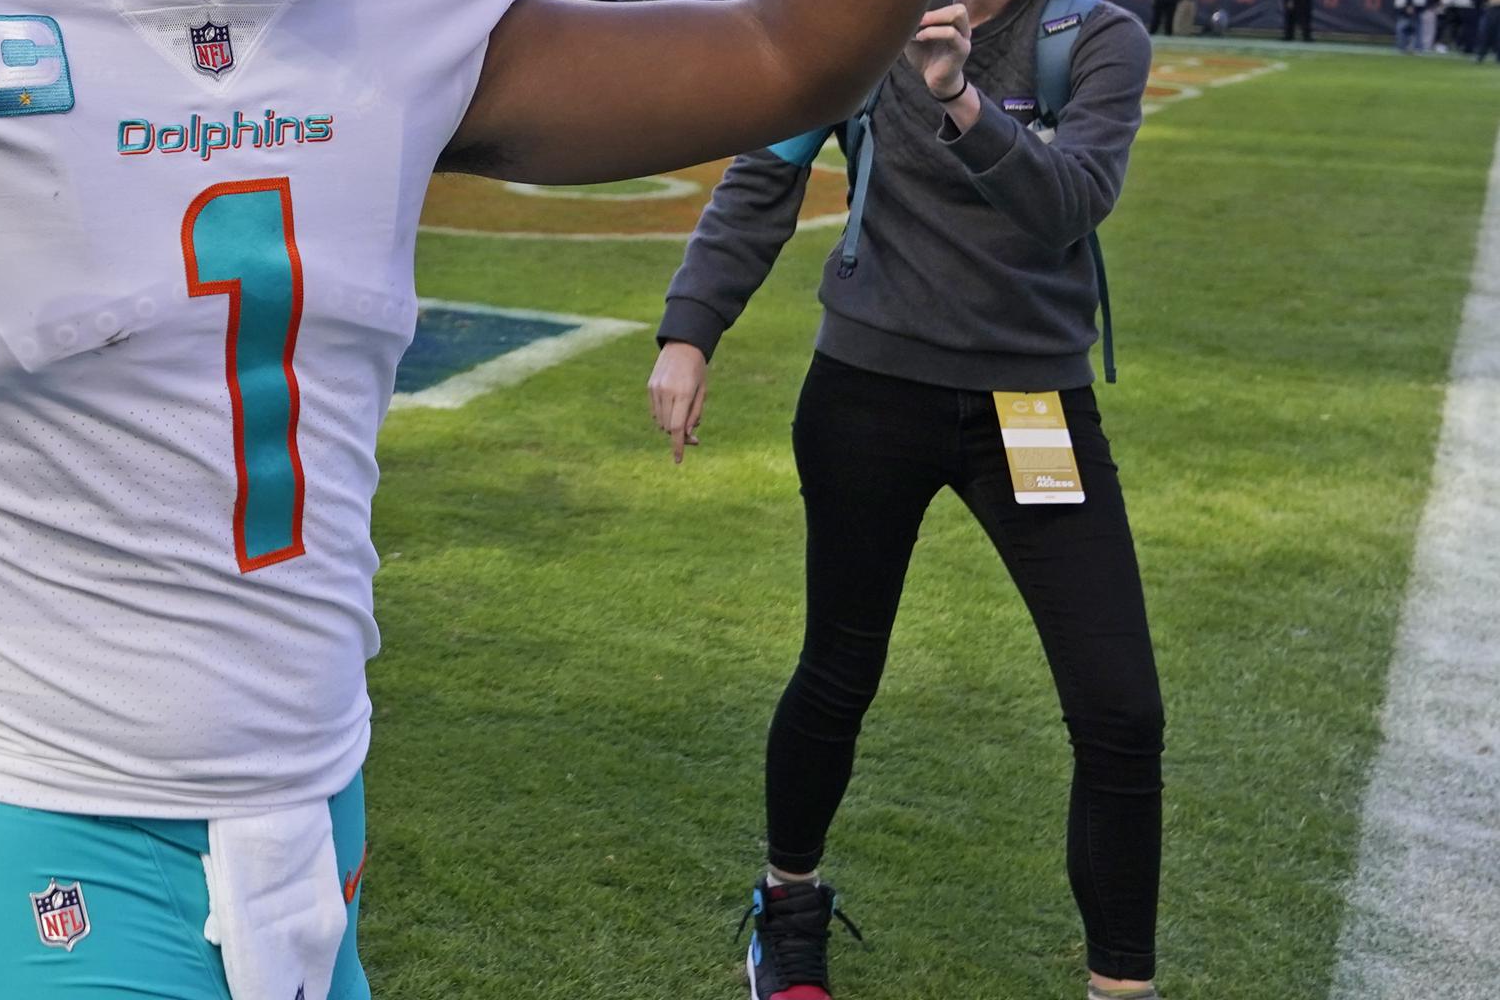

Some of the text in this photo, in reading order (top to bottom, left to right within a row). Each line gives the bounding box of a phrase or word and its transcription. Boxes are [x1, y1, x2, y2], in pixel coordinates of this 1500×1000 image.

[196, 42, 230, 67] NFL
[117, 109, 334, 161] Dolphins
[180, 176, 306, 574] 1
[44, 910, 82, 937] NFL
